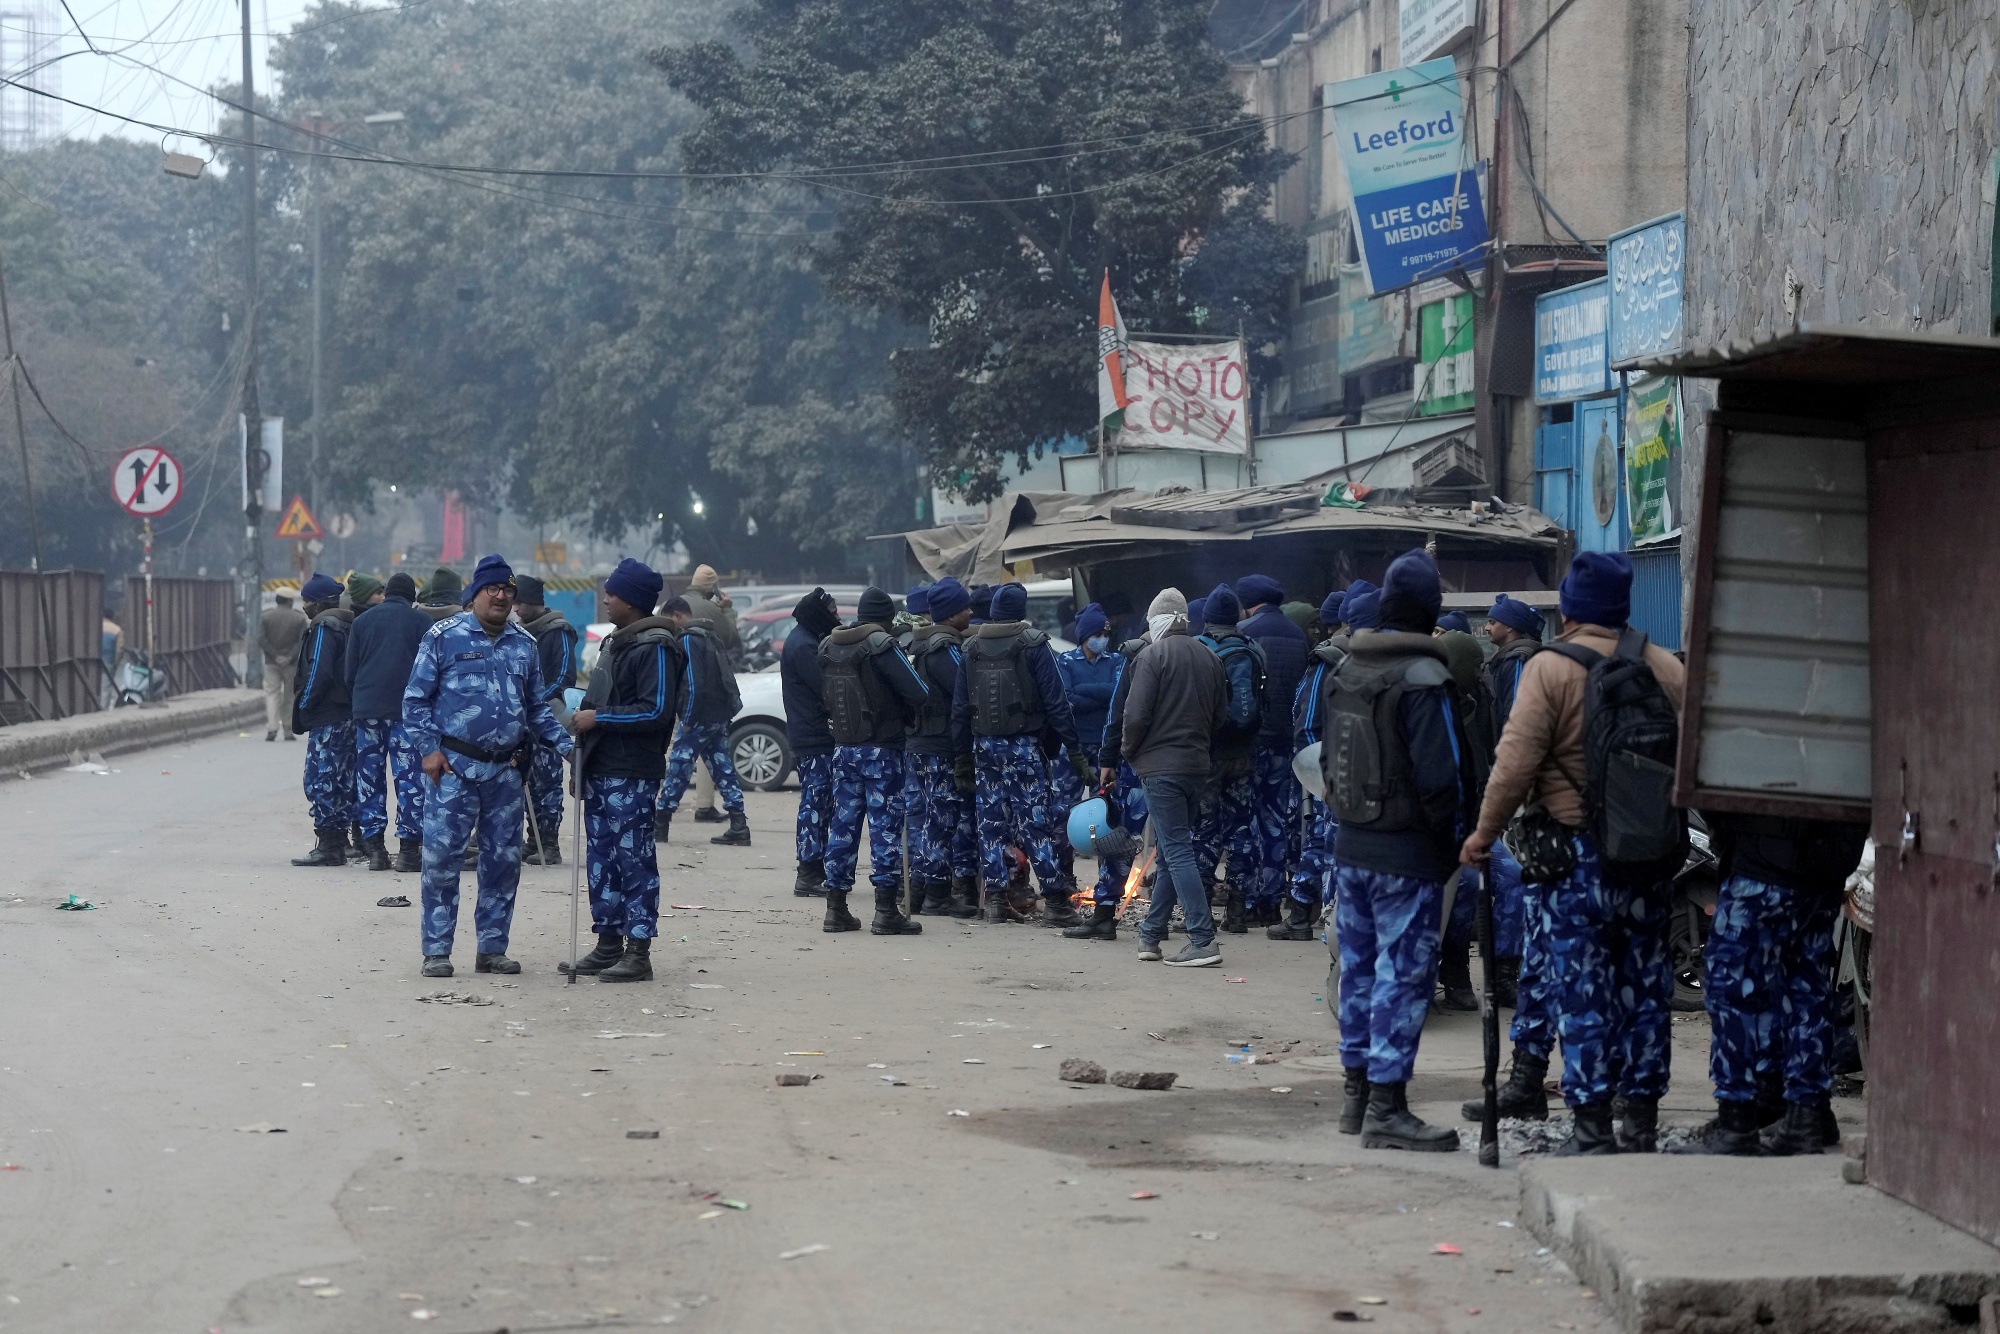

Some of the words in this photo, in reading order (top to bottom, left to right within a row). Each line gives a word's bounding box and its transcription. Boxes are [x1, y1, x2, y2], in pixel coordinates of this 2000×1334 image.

[1353, 110, 1455, 154] Leeford
[1382, 163, 1395, 171] Care
[1395, 161, 1402, 169] To
[1402, 158, 1418, 167] Serve
[1418, 155, 1428, 163] You
[1428, 151, 1447, 160] Better!
[1370, 206, 1413, 230] LIFE
[1384, 215, 1464, 246] MEDICOS
[1409, 247, 1459, 265] 99719-71975
[1570, 349, 1579, 368] OF
[1580, 343, 1603, 366] DELHI
[1126, 348, 1244, 401] PHOTO
[1122, 394, 1236, 443] COPY
[1240, 686, 1249, 717] CATCH
